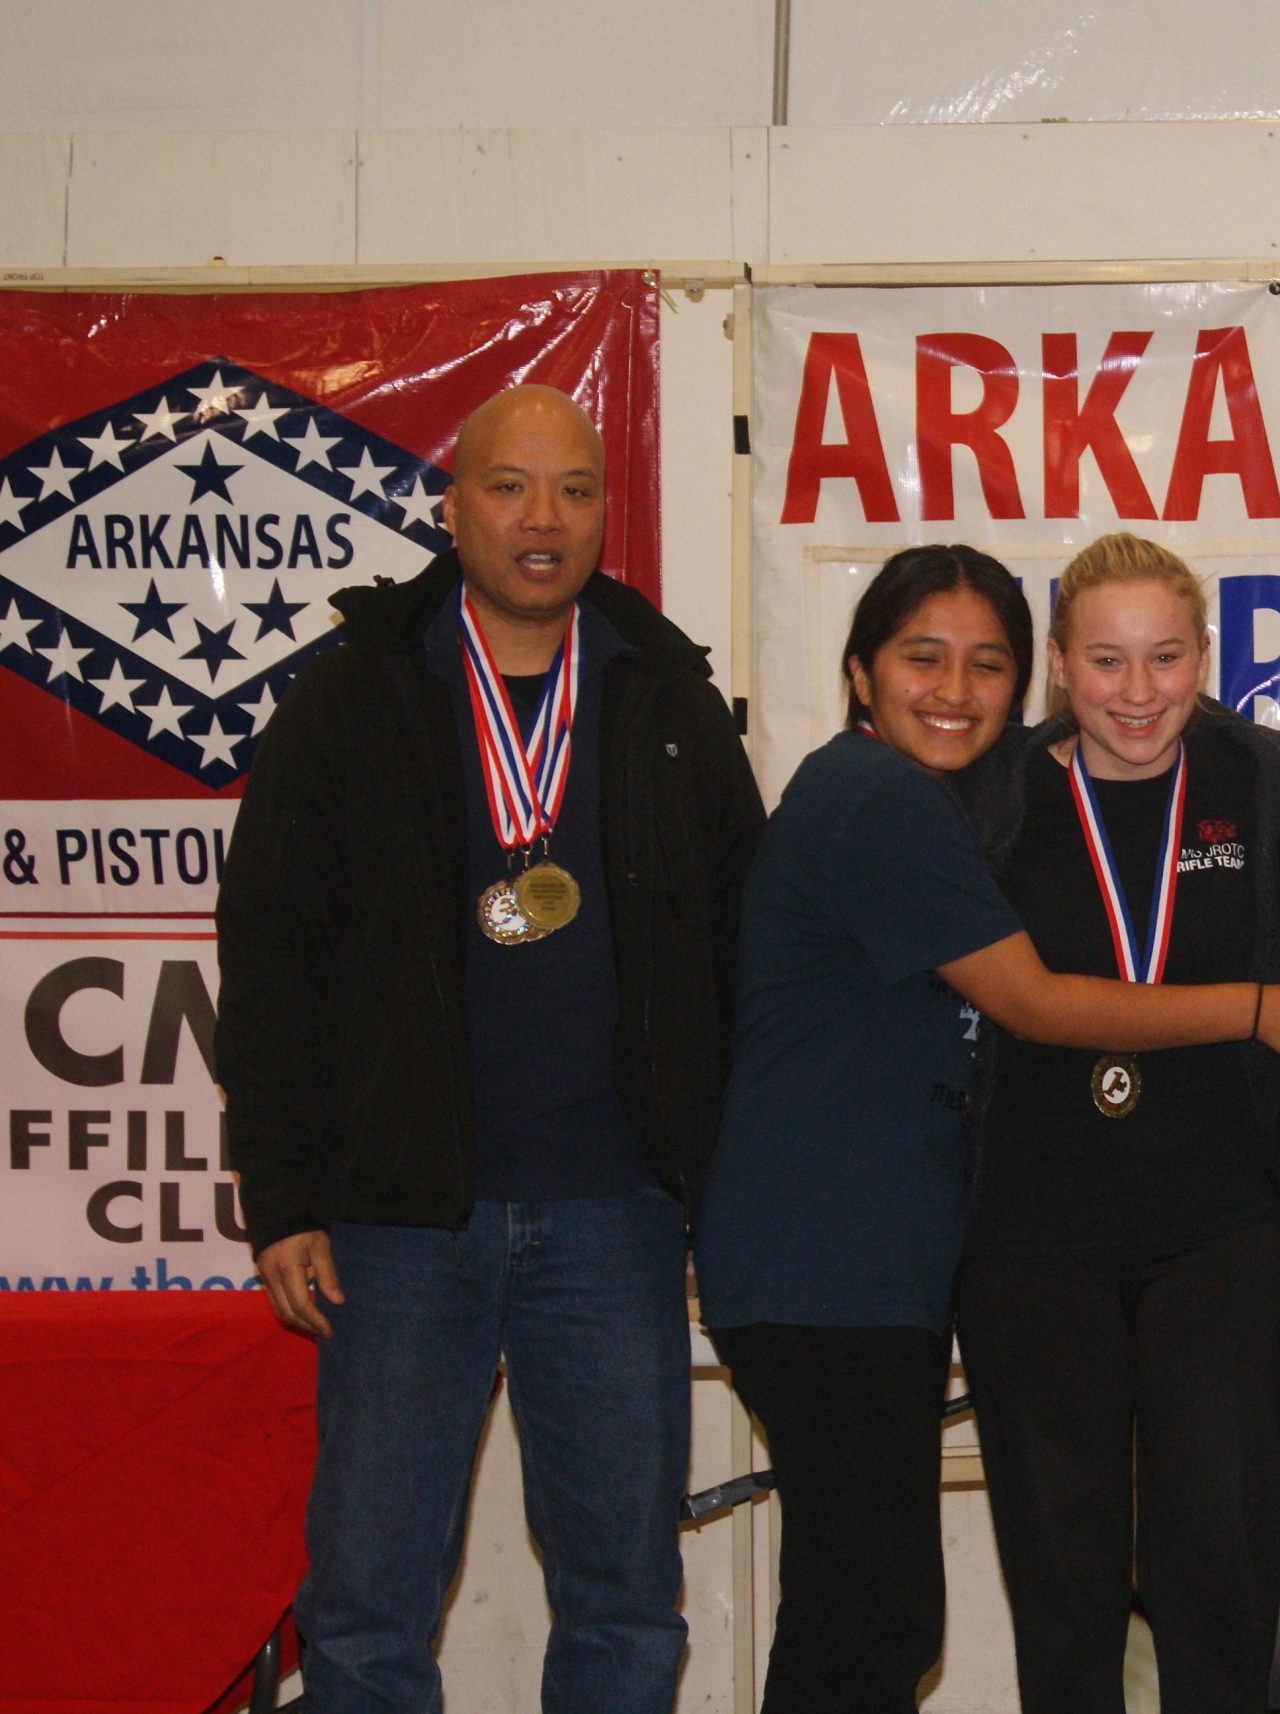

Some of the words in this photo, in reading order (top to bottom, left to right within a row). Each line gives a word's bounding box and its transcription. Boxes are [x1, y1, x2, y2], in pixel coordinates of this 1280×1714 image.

[66, 513, 355, 570] ARKANSAS
[2, 828, 40, 886] &
[1177, 858, 1213, 873] RIFLE
[1215, 855, 1244, 870] TEAM
[1206, 842, 1245, 859] JROTC
